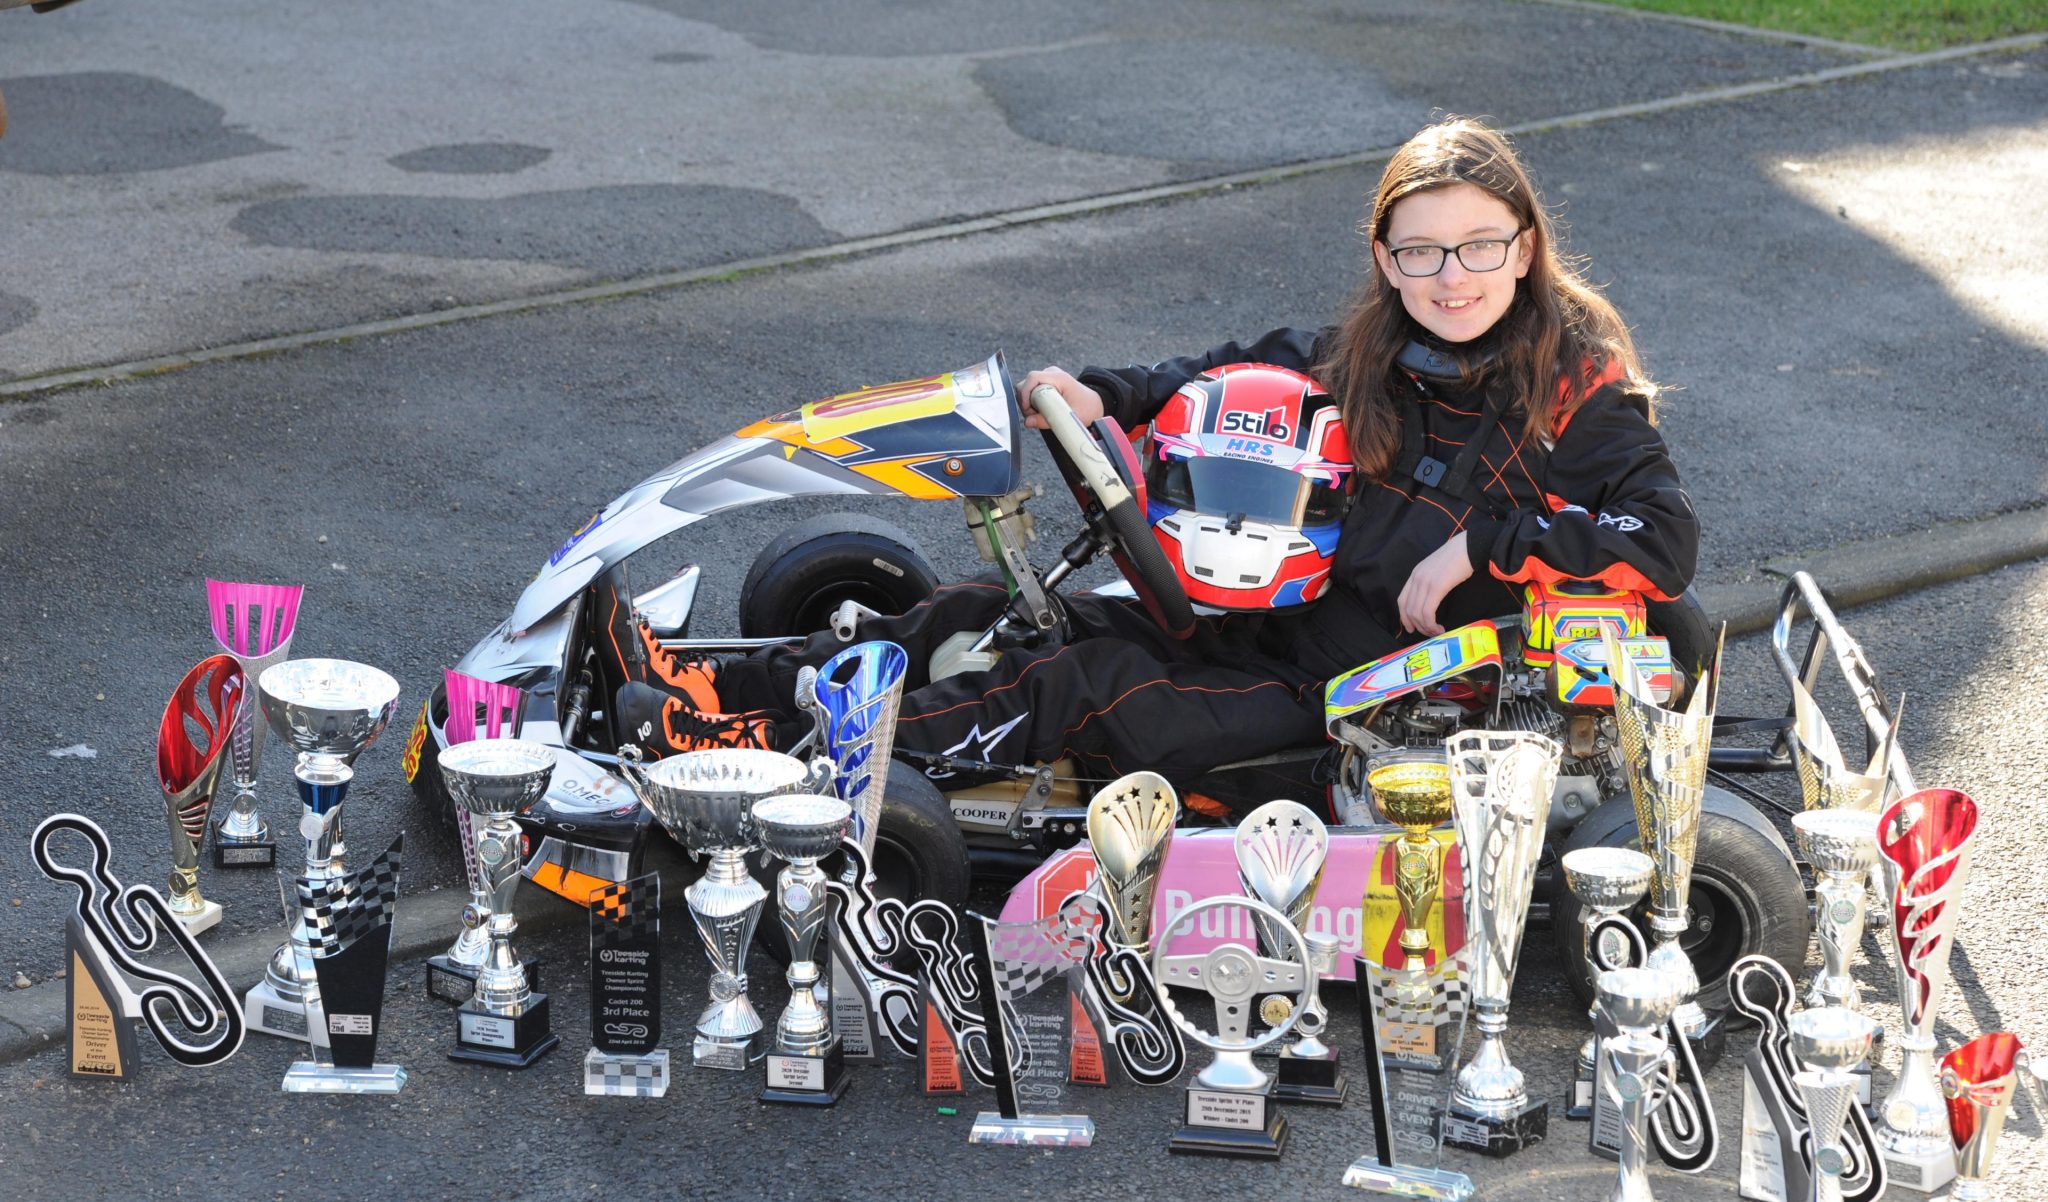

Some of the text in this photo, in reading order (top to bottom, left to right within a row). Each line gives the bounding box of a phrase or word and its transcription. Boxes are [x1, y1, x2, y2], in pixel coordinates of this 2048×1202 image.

[1223, 411, 1288, 439] Stilo
[1226, 438, 1274, 456] HRS
[953, 807, 1007, 820] COOPER
[612, 949, 650, 958] Teesside
[602, 1007, 650, 1017] 3rd Place
[86, 1040, 107, 1048] Driver
[1016, 1068, 1064, 1078] 2nd Place
[1398, 1091, 1437, 1106] DRIVER
[1399, 1112, 1435, 1126] EVENT
